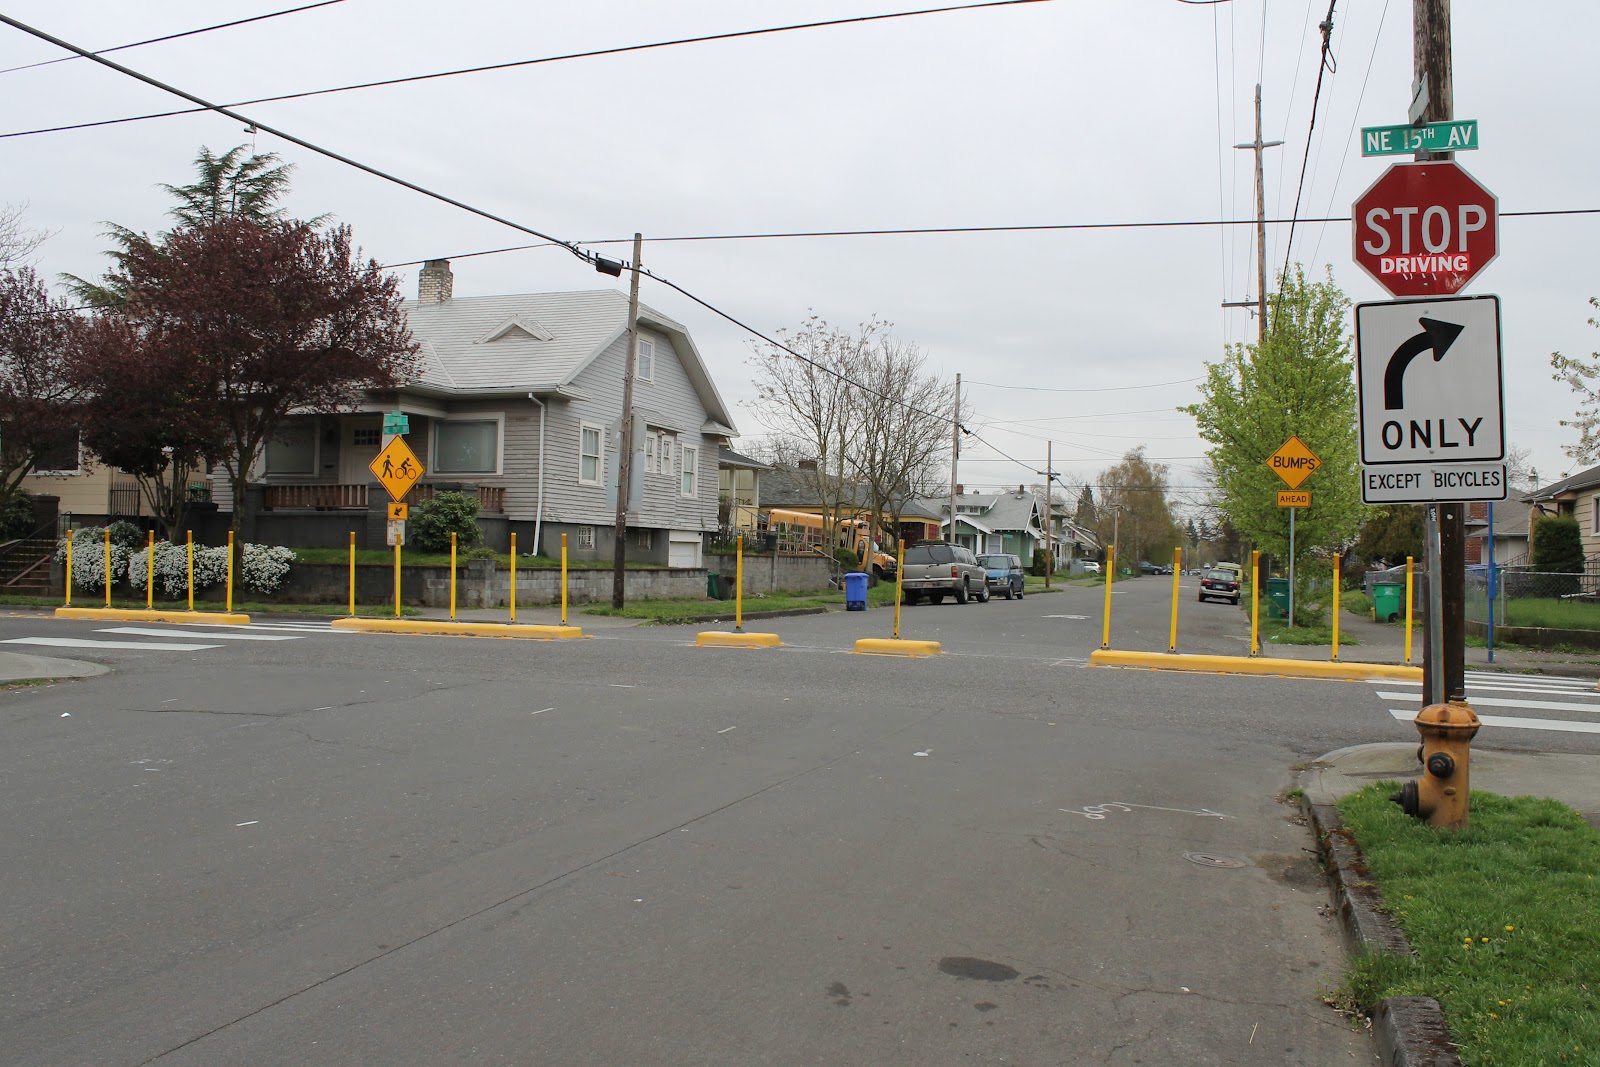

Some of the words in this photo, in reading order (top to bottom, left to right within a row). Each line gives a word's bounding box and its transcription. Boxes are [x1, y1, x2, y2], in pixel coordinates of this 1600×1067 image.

[1366, 131, 1393, 152] NE
[1402, 128, 1435, 150] 15TH
[1447, 125, 1473, 147] AV
[1363, 204, 1487, 256] STOP
[1380, 255, 1469, 274] DRIVING
[1381, 417, 1484, 450] ONLY
[1273, 456, 1316, 470] BUMPS
[1369, 473, 1422, 489] EXCEPT
[1434, 471, 1500, 488] BICYCLES
[1280, 495, 1307, 503] AHEAD
